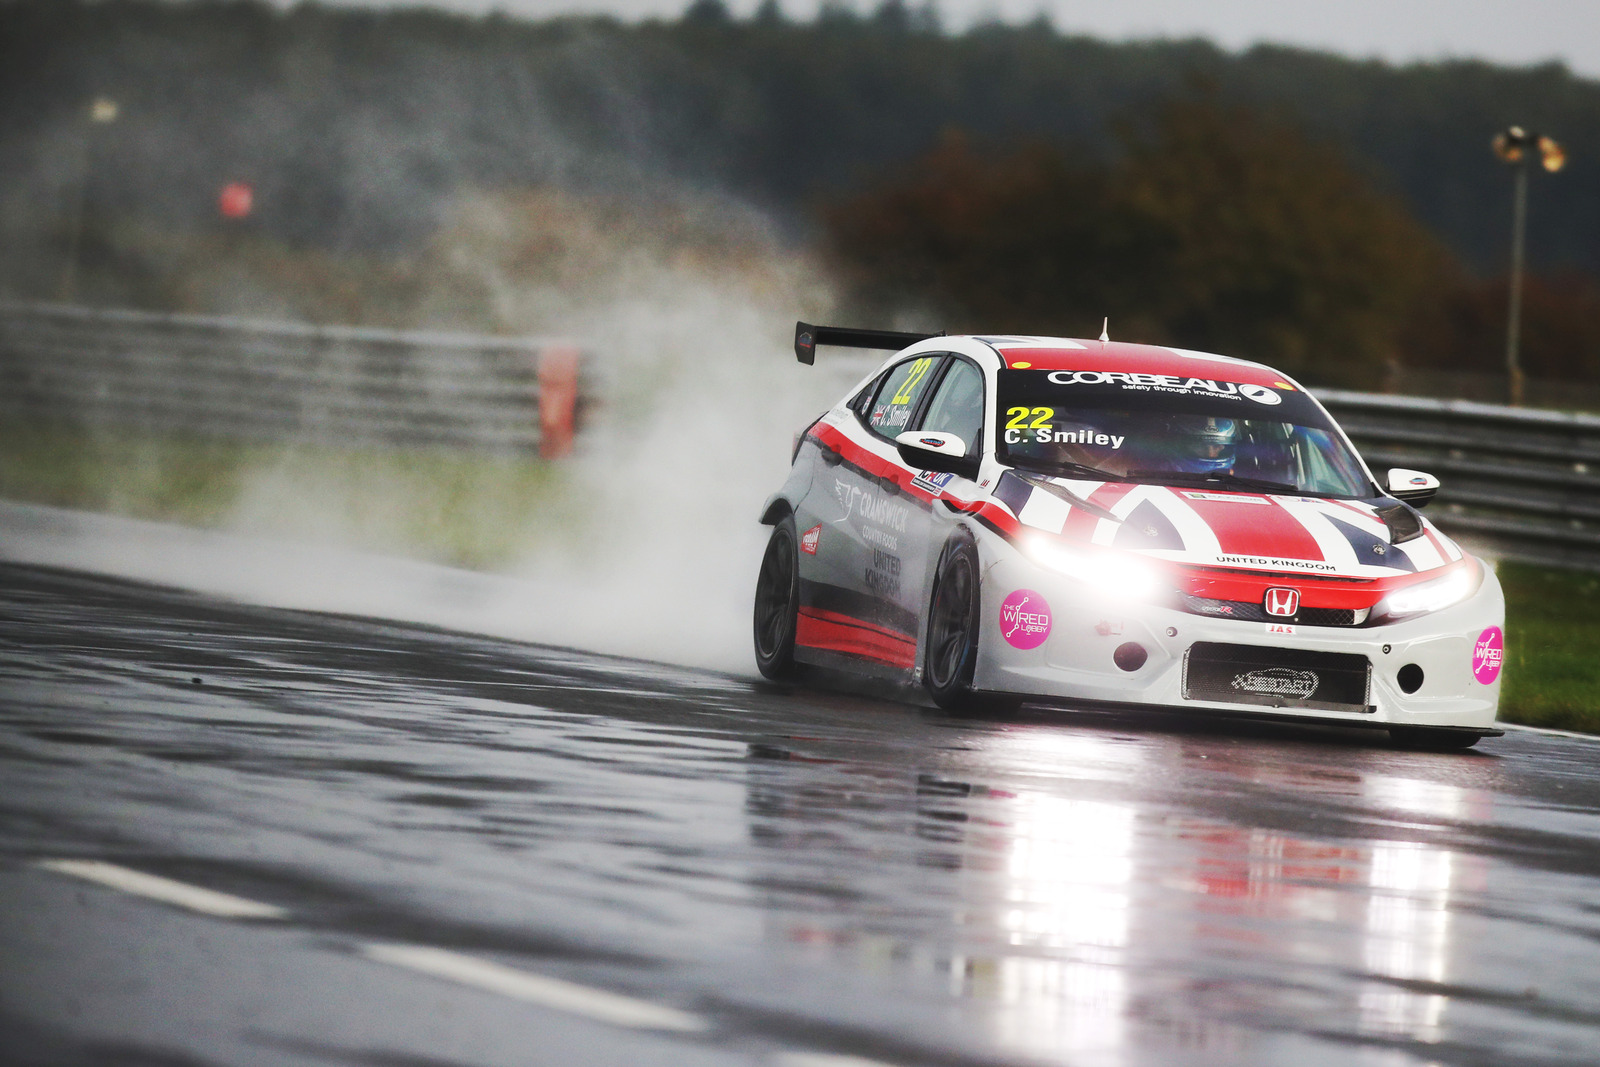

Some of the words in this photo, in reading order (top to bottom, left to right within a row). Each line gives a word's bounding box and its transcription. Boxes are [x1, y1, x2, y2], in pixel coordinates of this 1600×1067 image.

[891, 358, 932, 405] 22
[1047, 371, 1239, 395] CORBEAU
[1122, 384, 1151, 392] safety
[1153, 386, 1191, 394] through
[1193, 389, 1242, 400] innovation
[887, 405, 911, 431] Smiley
[1005, 407, 1055, 429] 22
[1004, 429, 1029, 444] C.
[1036, 428, 1125, 449] Smiley
[860, 492, 909, 533] CRANSWICK
[874, 548, 901, 577] UNITED
[1216, 556, 1267, 565] UNITED
[1271, 560, 1336, 571] KINGDOM
[1003, 610, 1048, 626] WIRED
[1021, 624, 1047, 634] LOBBY
[1269, 625, 1292, 633] JAS
